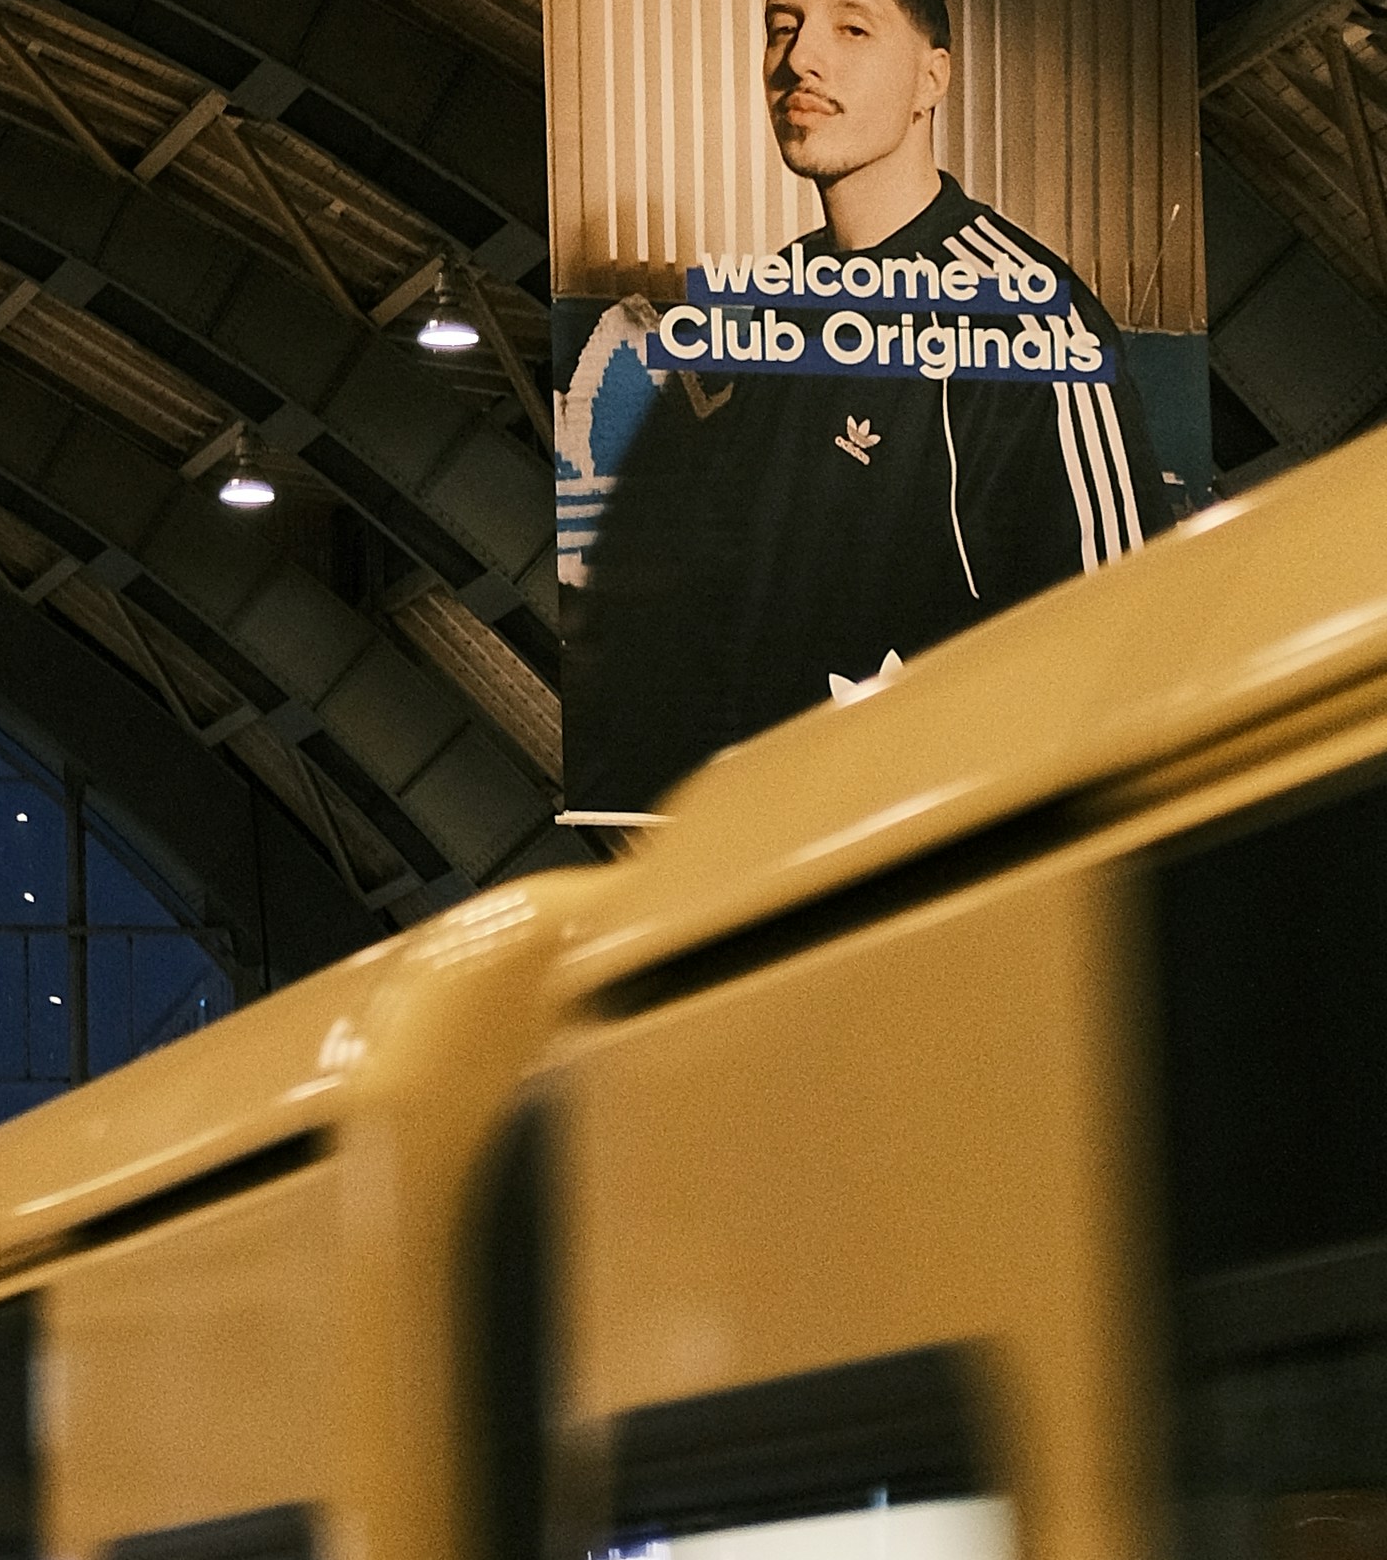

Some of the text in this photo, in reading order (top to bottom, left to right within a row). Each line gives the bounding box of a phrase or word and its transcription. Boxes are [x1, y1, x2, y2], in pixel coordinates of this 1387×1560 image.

[703, 242, 1058, 304] welcome to
[659, 305, 1103, 379] Club Originals
